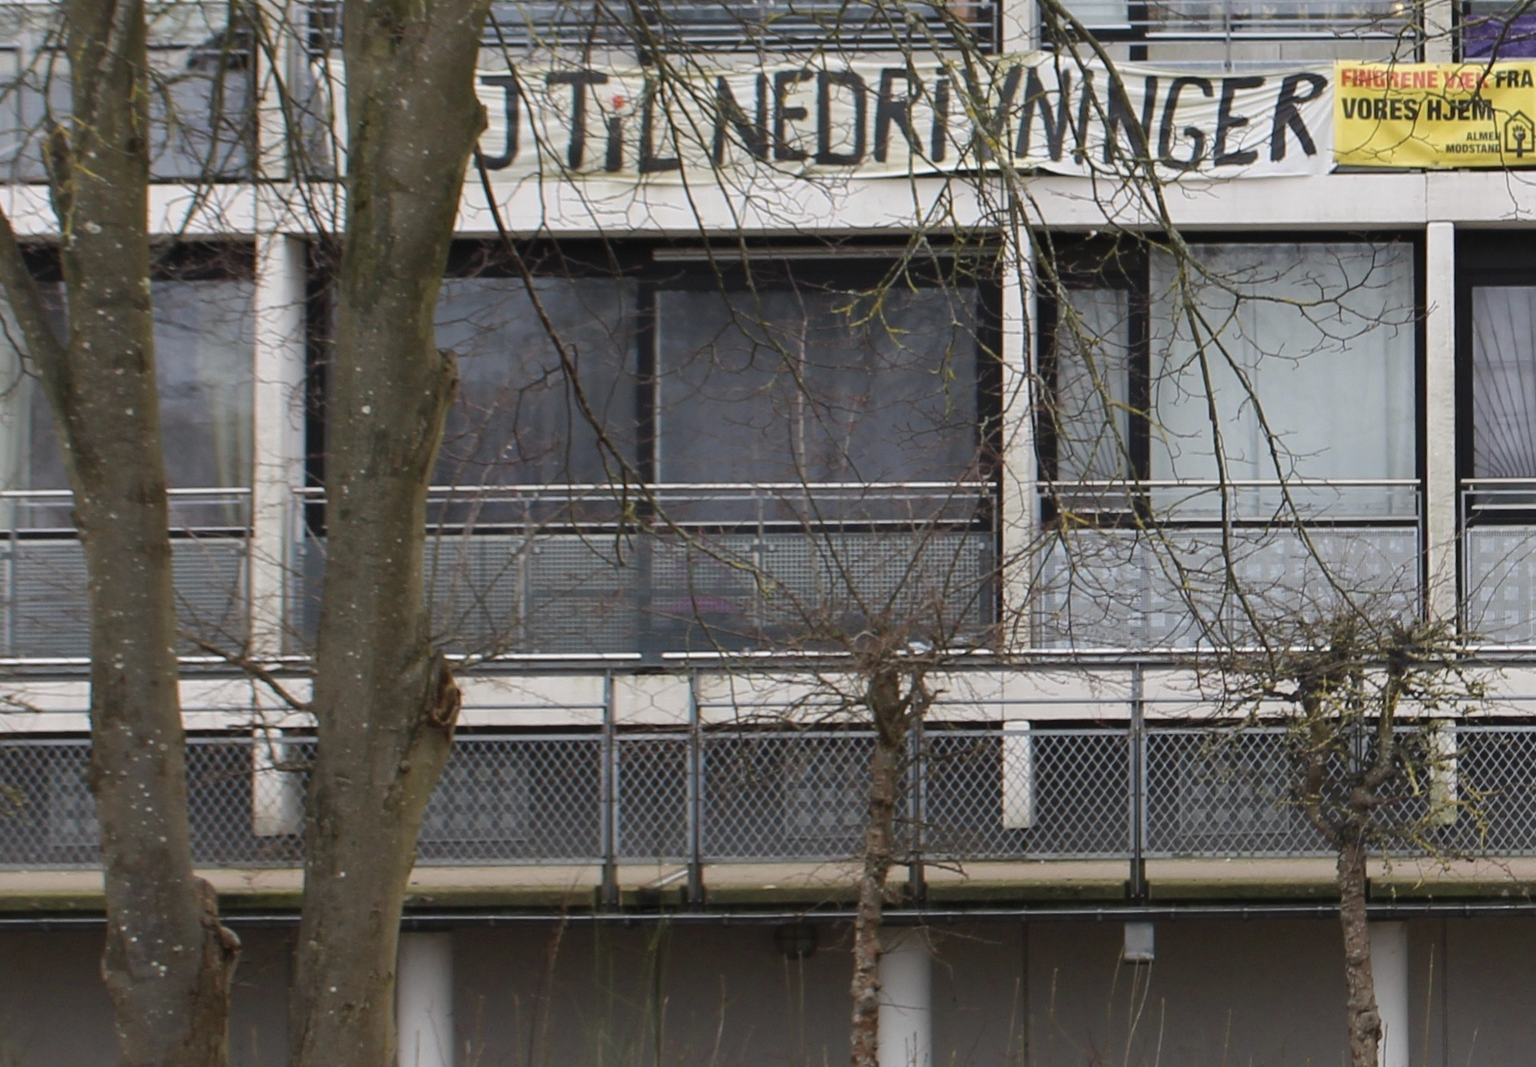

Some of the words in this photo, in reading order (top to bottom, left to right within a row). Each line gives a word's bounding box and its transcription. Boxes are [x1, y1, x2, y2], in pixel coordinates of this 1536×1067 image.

[1341, 68, 1438, 89] FINGRENE
[1444, 70, 1490, 89] VÆK
[1496, 69, 1534, 88] FRA
[1342, 97, 1417, 120] VORES
[1427, 98, 1492, 120] HJEM
[1466, 131, 1501, 141] ALMEN
[1446, 143, 1501, 154] MODSTAND
